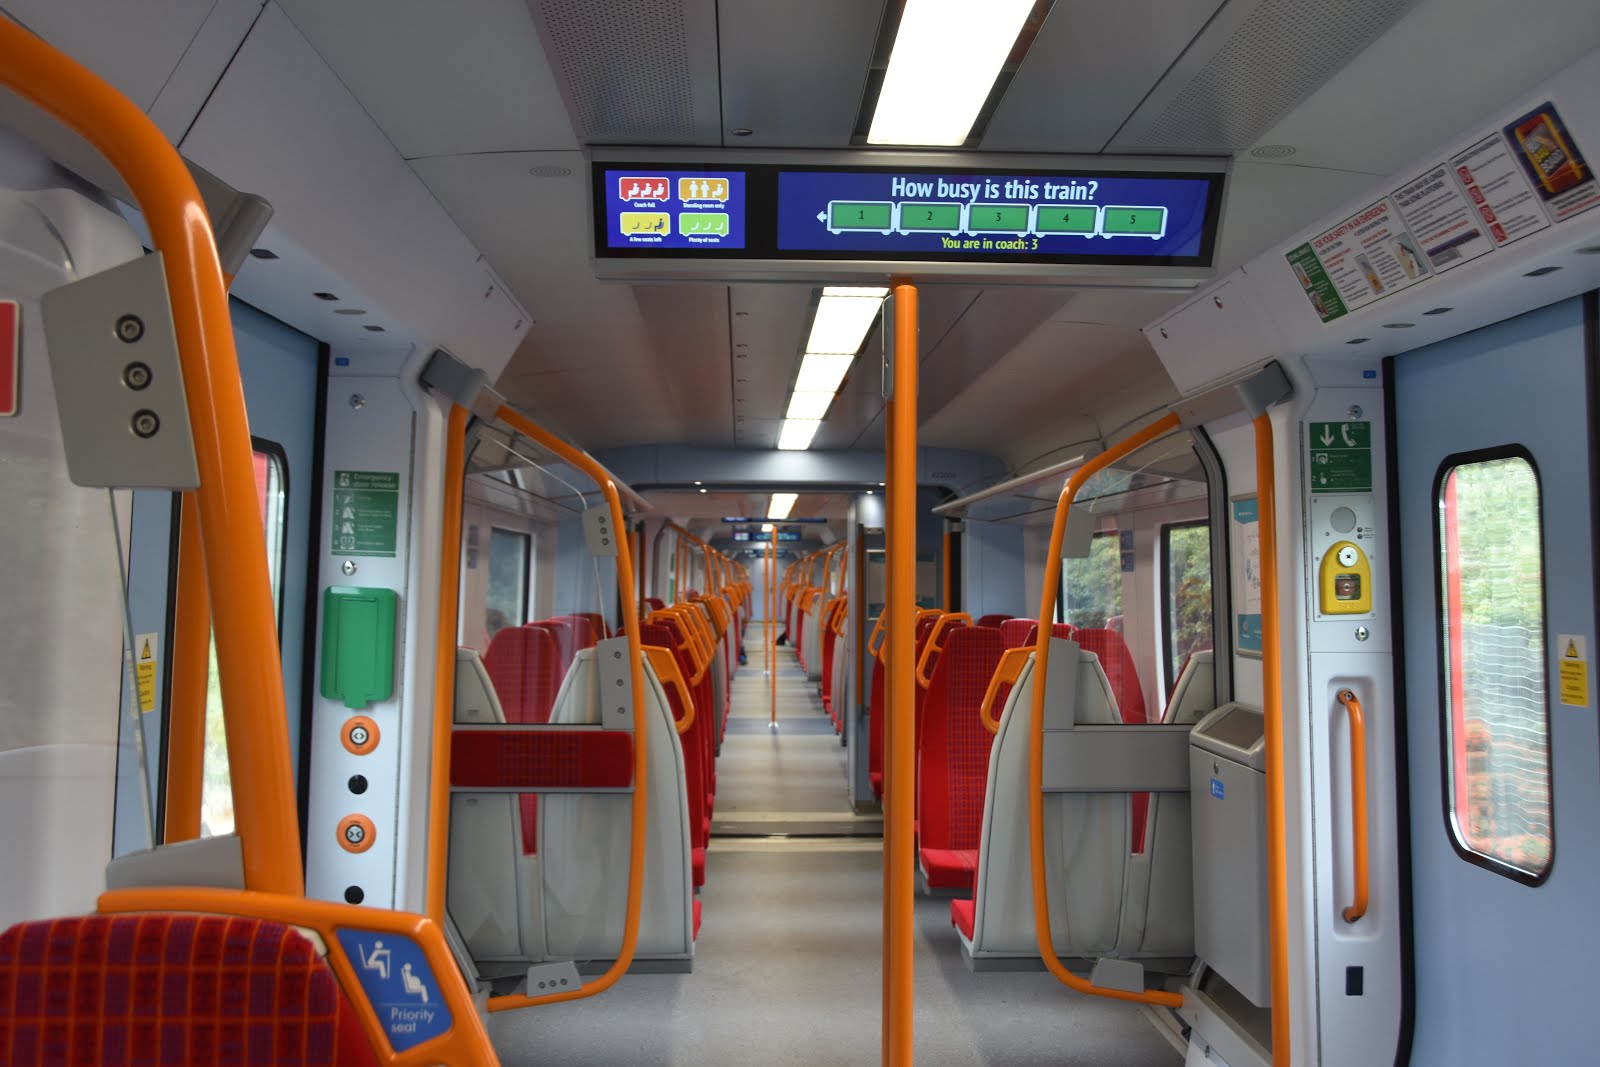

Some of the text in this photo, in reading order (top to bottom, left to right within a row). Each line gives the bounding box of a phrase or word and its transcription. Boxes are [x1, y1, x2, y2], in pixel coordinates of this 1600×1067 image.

[891, 177, 1099, 203] How busy is this train?
[858, 210, 864, 220] 1
[927, 211, 933, 221] 2
[995, 212, 1002, 222] 3
[1063, 213, 1070, 223] 4
[1130, 215, 1136, 225] 5
[941, 237, 1038, 250] You are in coach: 3
[390, 1006, 435, 1024] Priority
[390, 1022, 417, 1033] seat
